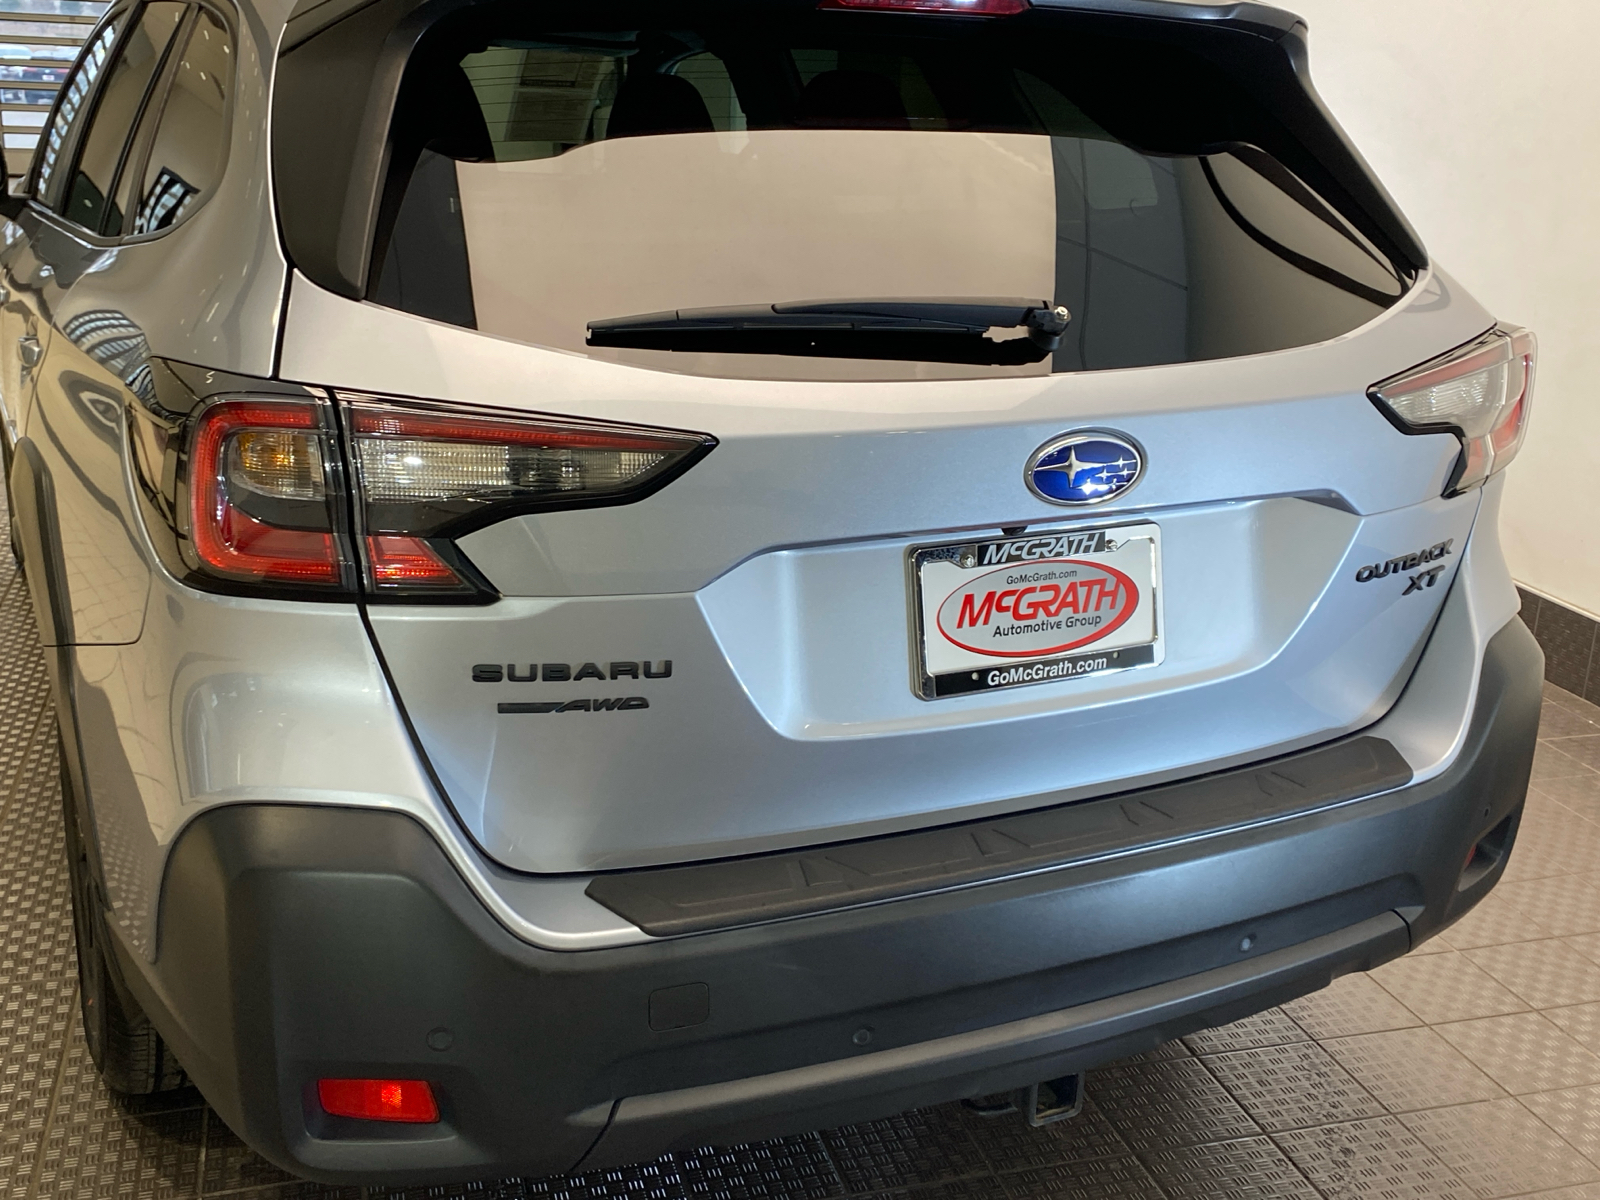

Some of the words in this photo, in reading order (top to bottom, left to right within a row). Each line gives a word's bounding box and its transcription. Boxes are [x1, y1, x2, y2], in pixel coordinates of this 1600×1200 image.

[1355, 538, 1454, 582] OUTBACK
[1006, 569, 1078, 585] GoMcGrath.com
[1401, 564, 1446, 596] XT
[992, 619, 1063, 637] Automotive
[1065, 614, 1102, 629] Group
[472, 660, 673, 683] SUBARU
[987, 656, 1107, 686] GoMcGrath.com
[555, 696, 650, 713] AWD
